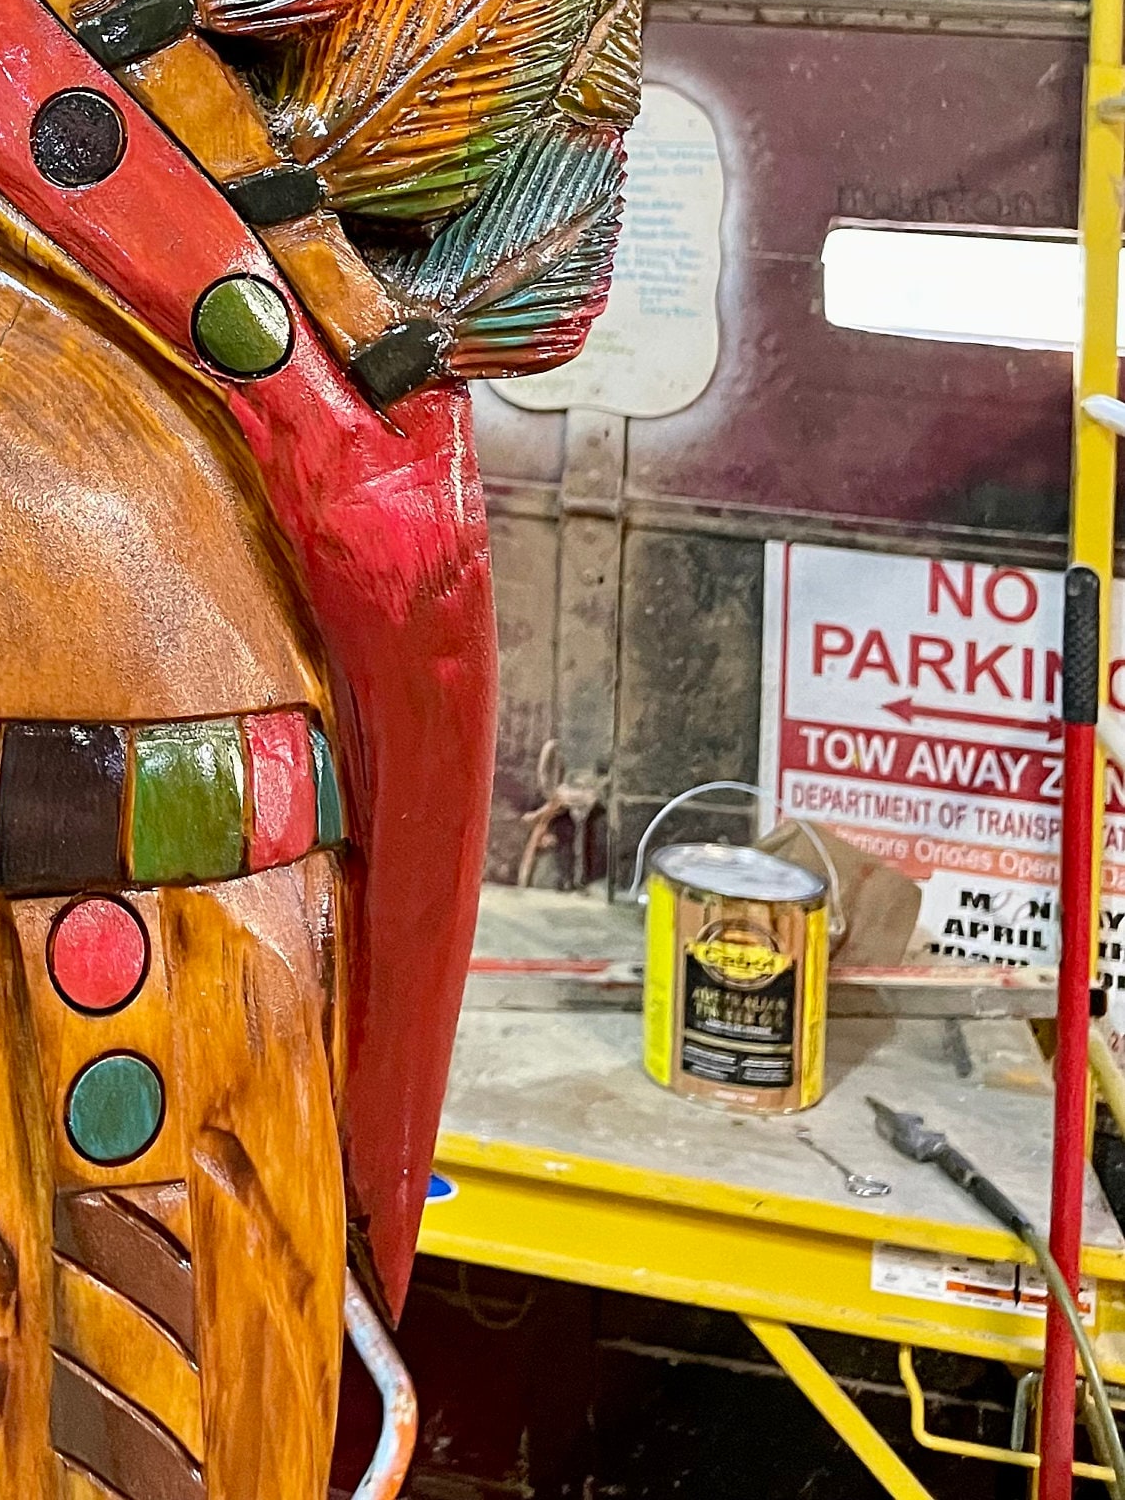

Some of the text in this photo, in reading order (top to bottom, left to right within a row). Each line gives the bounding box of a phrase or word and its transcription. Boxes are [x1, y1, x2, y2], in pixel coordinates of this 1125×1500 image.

[928, 560, 1038, 623] NO
[799, 726, 898, 776] TOW
[906, 741, 1030, 794] AWAY
[791, 782, 932, 826] DEPARTMENT
[938, 802, 968, 830] OF
[942, 918, 1048, 951] APRIL
